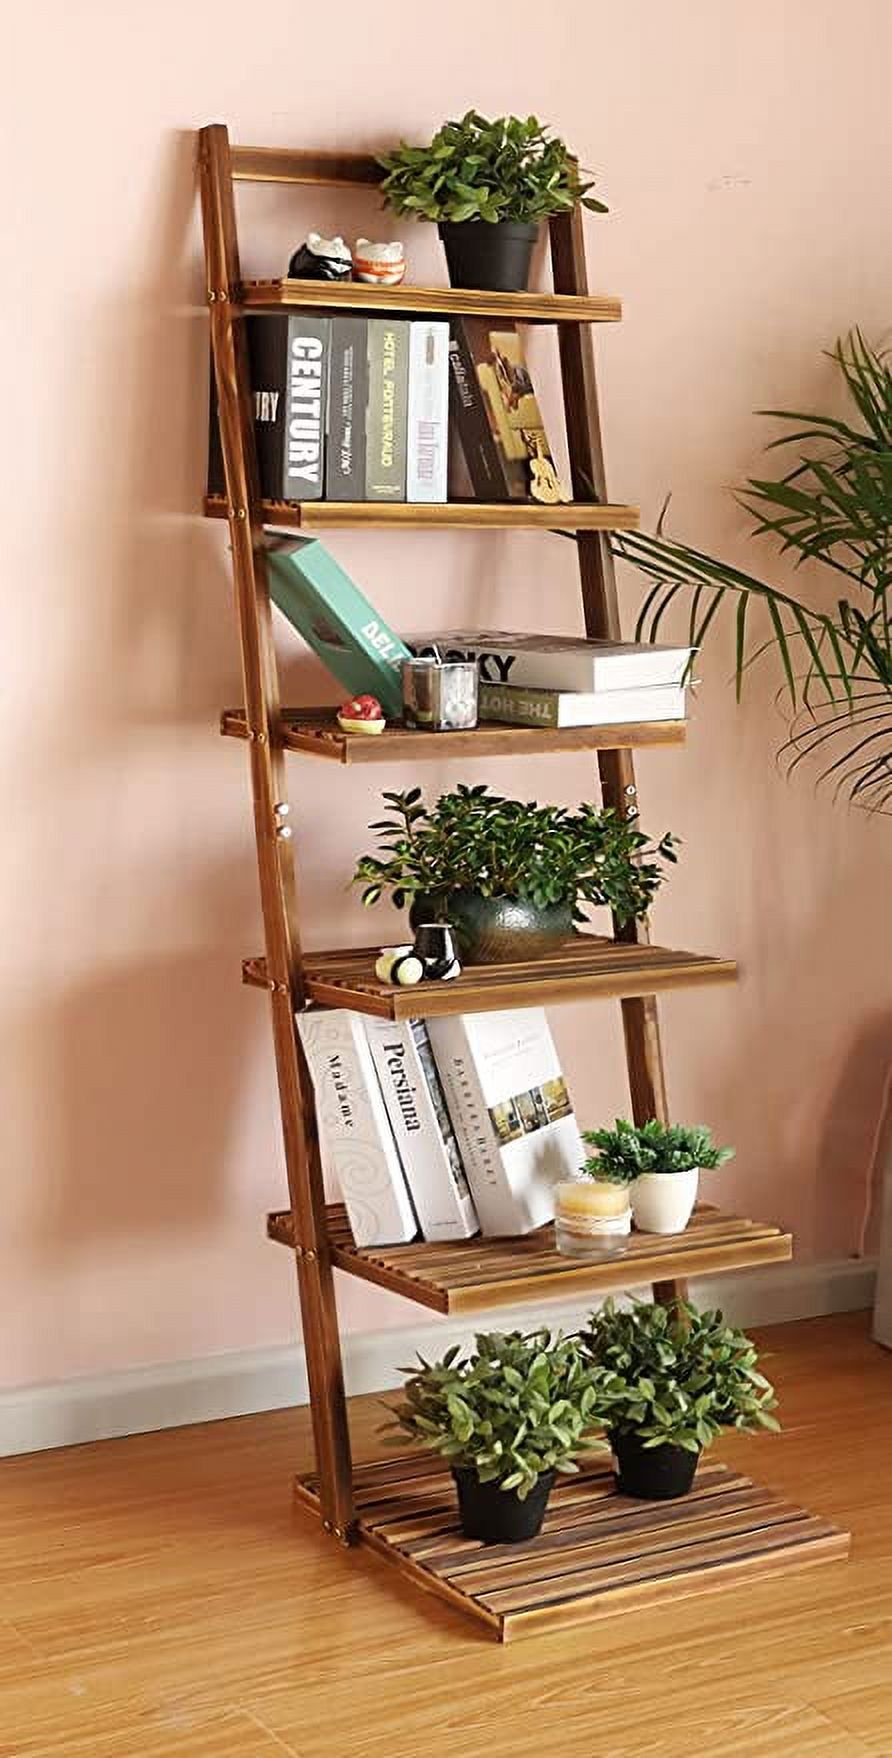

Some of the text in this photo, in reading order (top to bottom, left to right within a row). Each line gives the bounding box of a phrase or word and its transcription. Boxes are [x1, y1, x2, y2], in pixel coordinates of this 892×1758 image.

[383, 332, 396, 376] HOTEL
[287, 336, 323, 483] CENTURY
[518, 701, 553, 719] THE
[327, 1054, 354, 1128] Madame
[383, 1041, 422, 1131] Persiana
